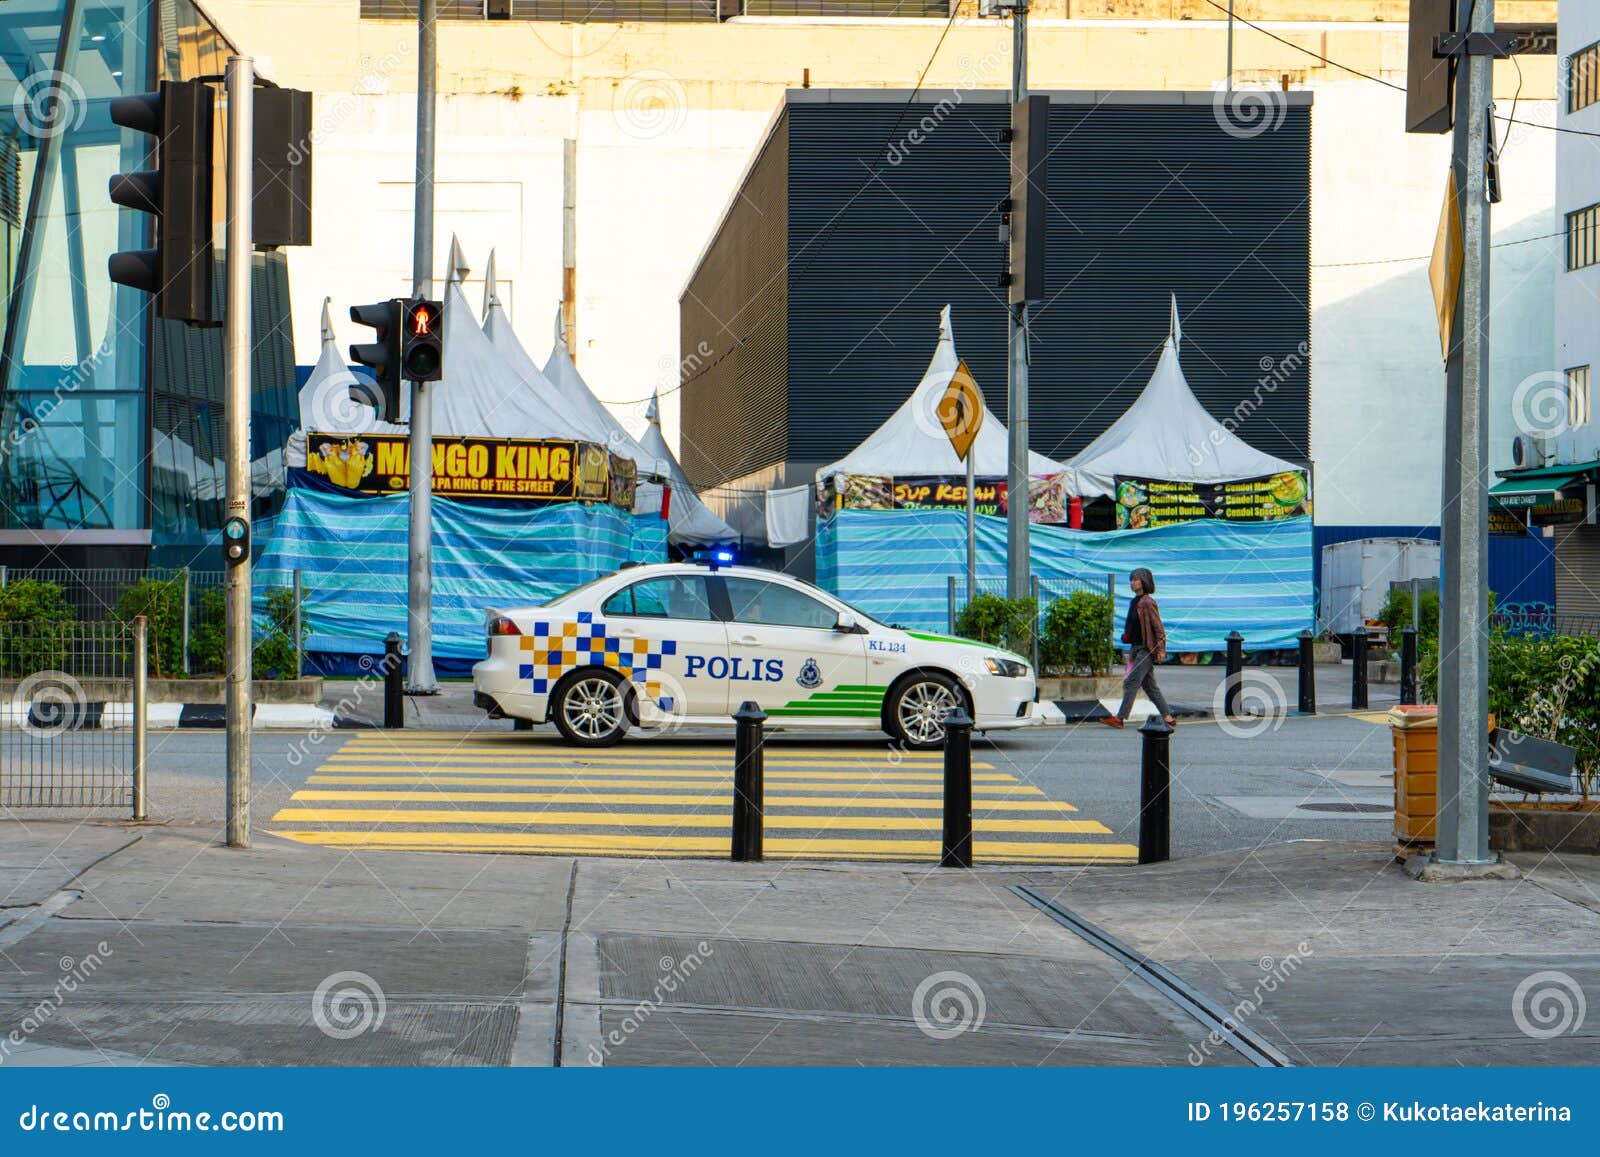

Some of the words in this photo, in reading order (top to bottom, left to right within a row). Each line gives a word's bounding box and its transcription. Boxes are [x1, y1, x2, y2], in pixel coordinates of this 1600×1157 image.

[496, 446, 571, 480] KING
[453, 478, 479, 491] KING
[480, 480, 496, 492] OF
[496, 480, 516, 492] THE
[517, 481, 556, 493] STREET
[1150, 494, 1178, 504] Cendol
[1225, 494, 1253, 505] Cendol
[1150, 506, 1178, 516] Cendol
[1178, 506, 1206, 515] Durian
[1225, 506, 1254, 518] Cendol
[868, 640, 886, 652] KL
[887, 642, 907, 654] 134
[684, 655, 784, 683] POLIS
